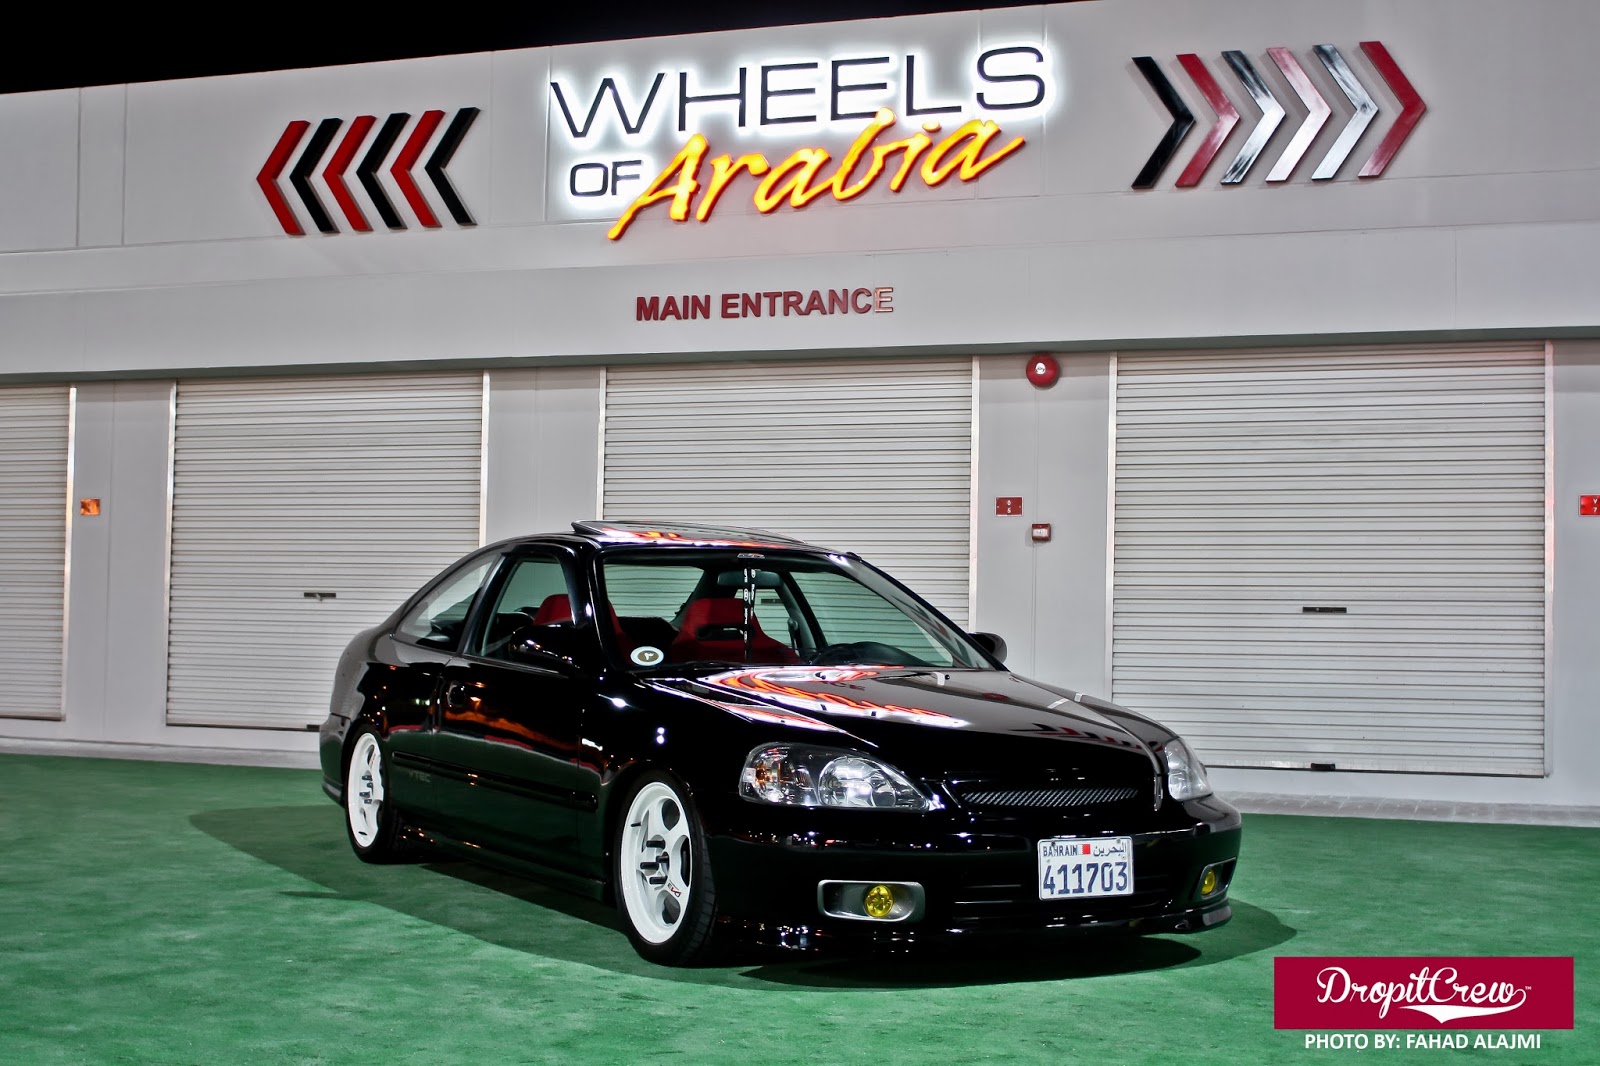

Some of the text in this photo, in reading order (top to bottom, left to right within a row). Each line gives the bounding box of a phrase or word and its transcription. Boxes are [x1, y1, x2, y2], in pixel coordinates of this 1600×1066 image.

[550, 46, 1045, 138] WHEELS
[569, 107, 1024, 241] OF Arabia
[635, 286, 894, 322] MAIN ENTRANCE
[408, 769, 431, 783] VTEC
[1042, 844, 1078, 858] BAHRAIN
[1093, 842, 1127, 857] البحرين
[1043, 861, 1128, 895] 411703
